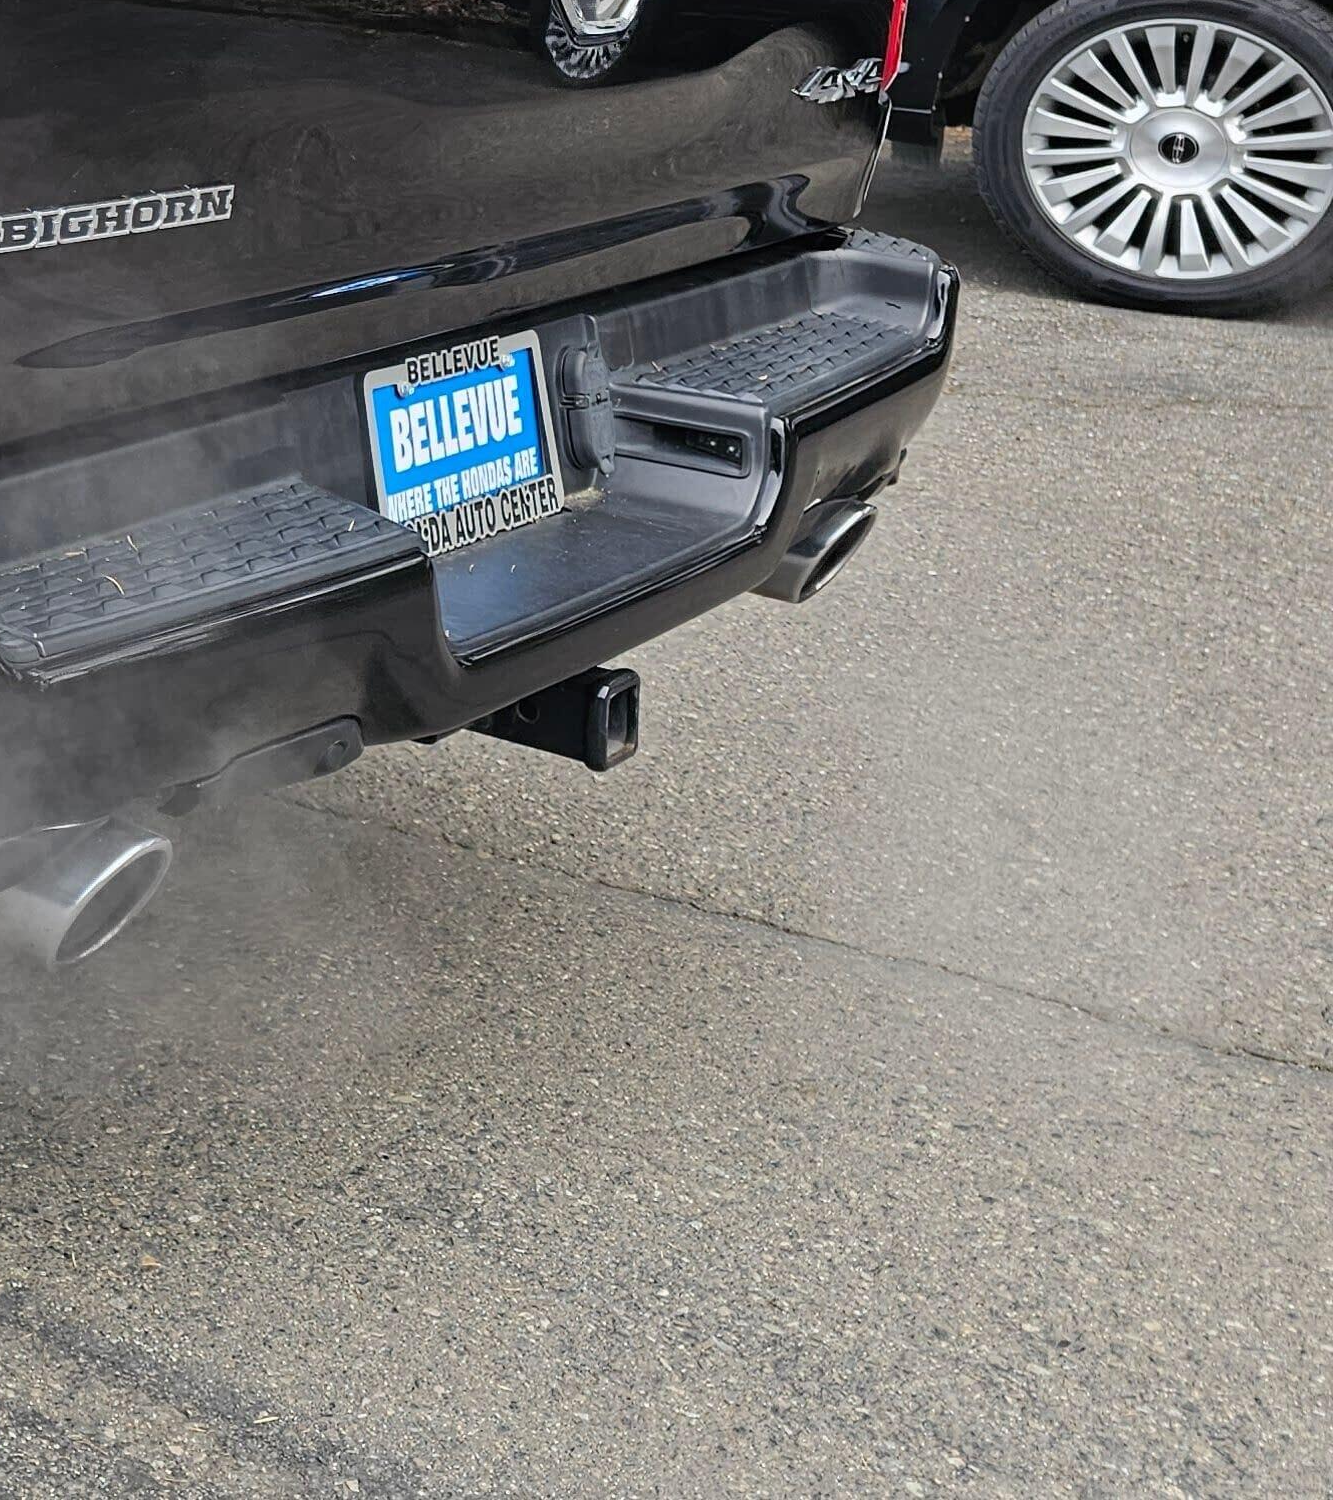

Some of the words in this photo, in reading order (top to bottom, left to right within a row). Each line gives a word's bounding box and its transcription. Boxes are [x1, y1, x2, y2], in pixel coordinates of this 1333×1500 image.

[406, 338, 500, 384] BELLEVUE
[389, 374, 523, 473] BELLEVUE
[433, 473, 460, 509] THE
[461, 455, 513, 498] HONDAS
[514, 446, 539, 482] ARE
[406, 514, 453, 556] NDA
[455, 498, 496, 545] AUTO
[500, 477, 560, 525] CENTER
